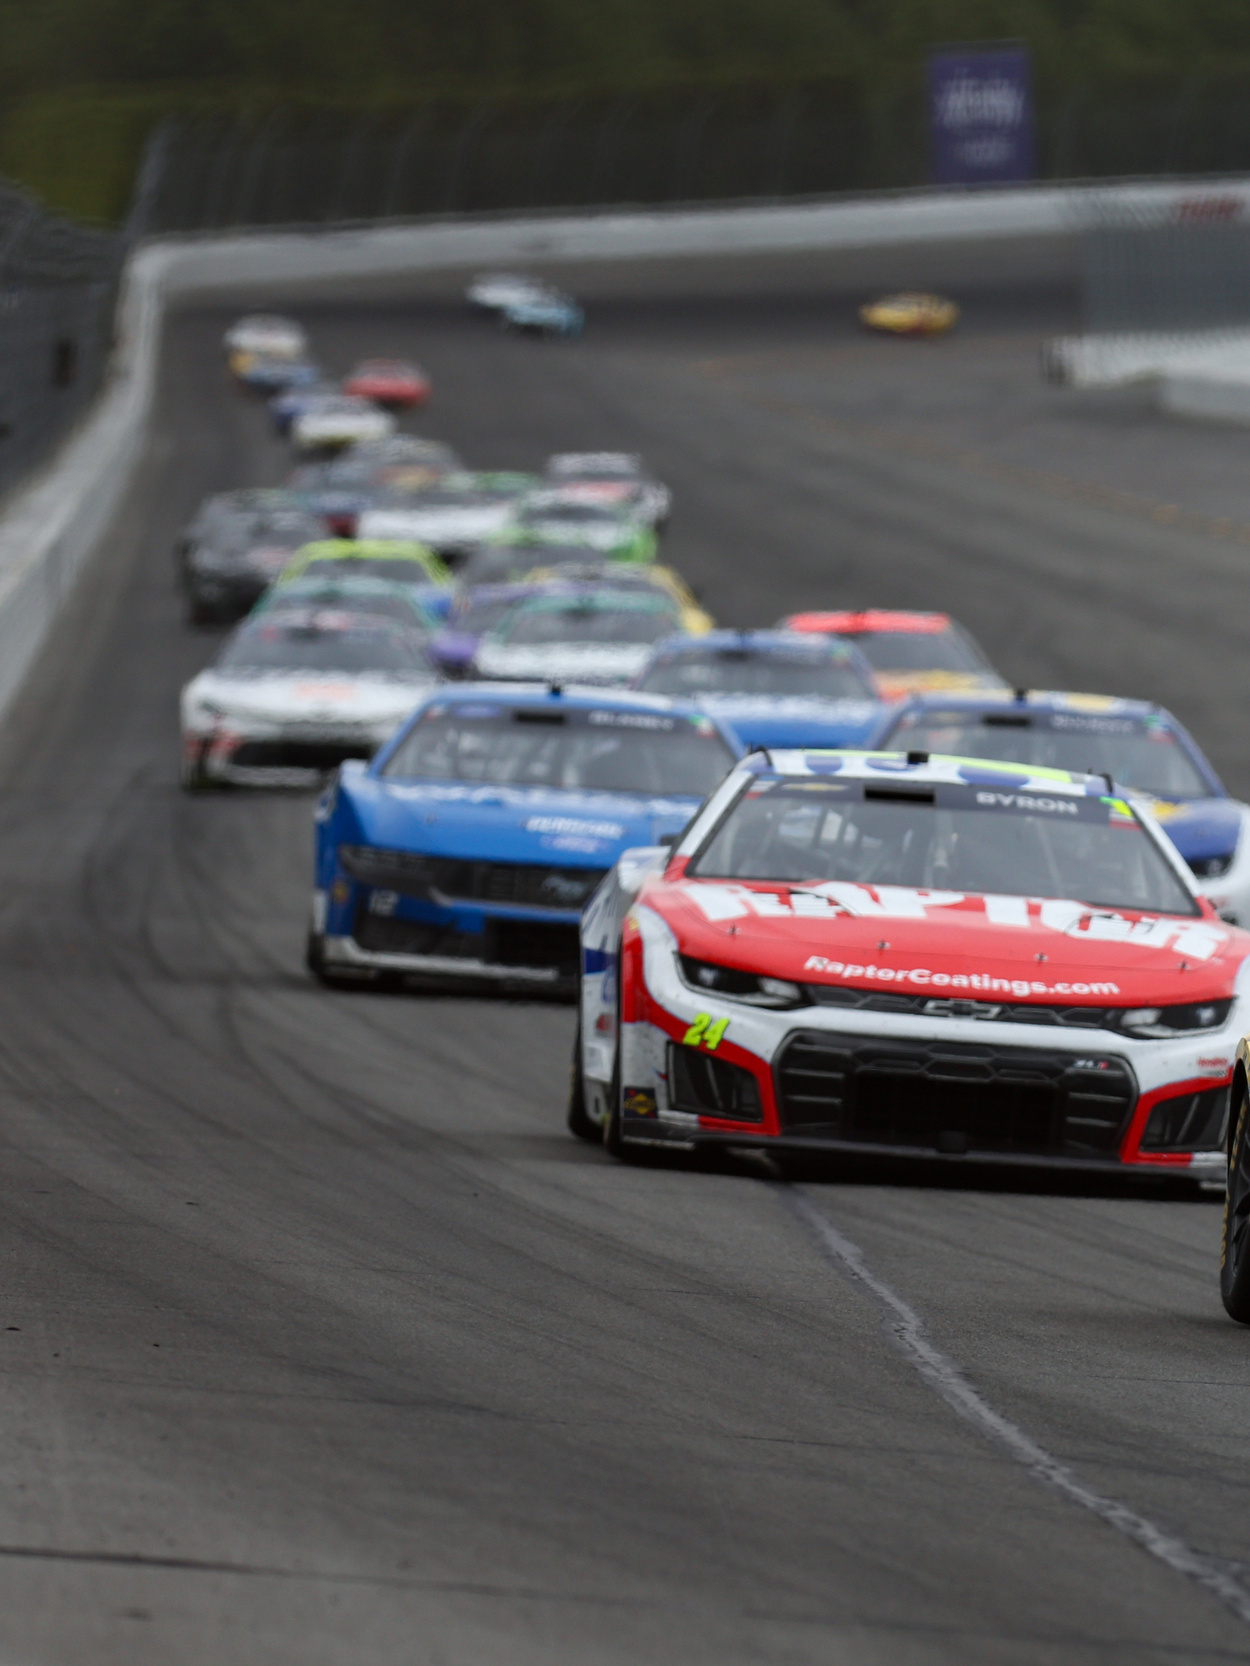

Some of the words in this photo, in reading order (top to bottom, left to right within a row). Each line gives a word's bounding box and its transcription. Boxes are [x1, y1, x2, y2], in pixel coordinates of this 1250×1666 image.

[976, 791, 1078, 814] BYRON
[804, 955, 1120, 997] RaptorCoatings.com
[682, 1012, 730, 1050] 24
